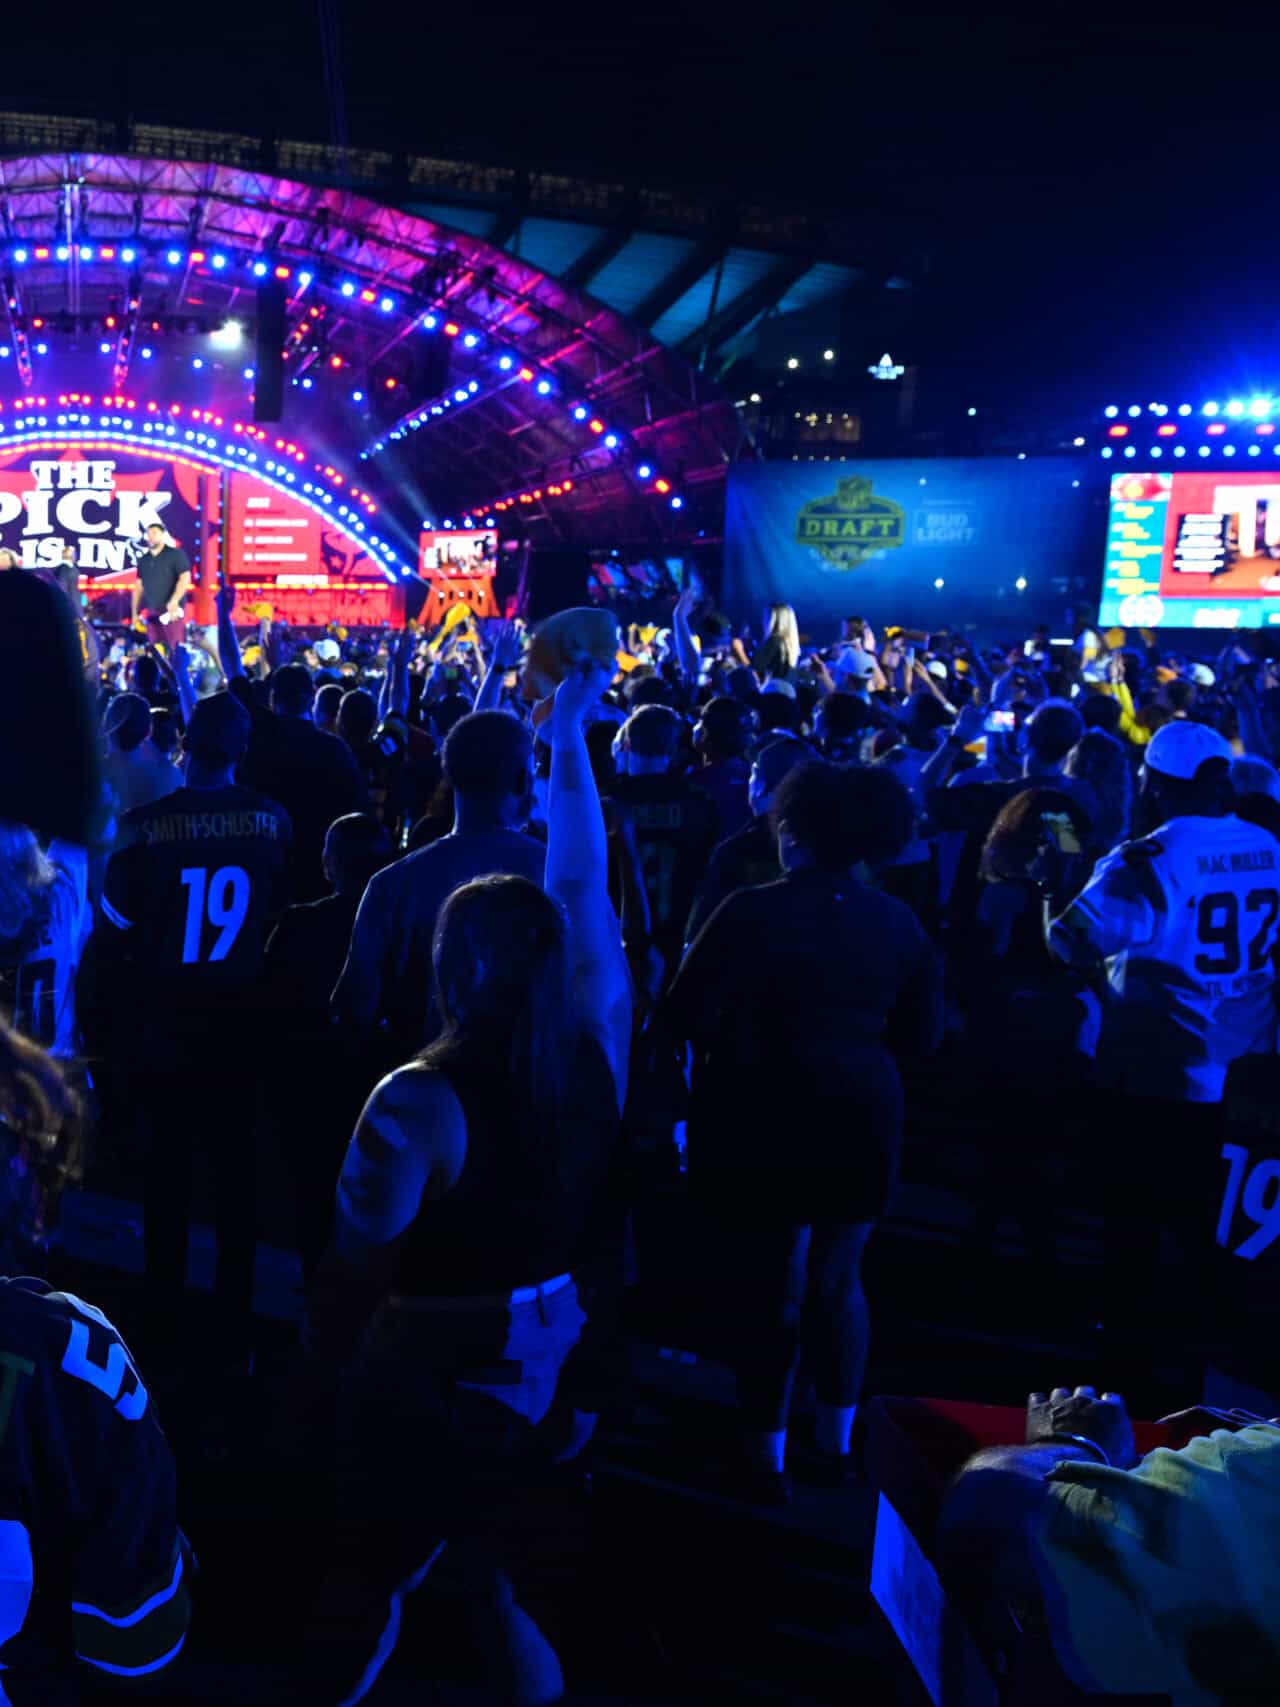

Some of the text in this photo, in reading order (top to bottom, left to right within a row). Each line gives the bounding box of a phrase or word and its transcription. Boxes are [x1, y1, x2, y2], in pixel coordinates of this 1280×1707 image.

[30, 461, 116, 489] THE
[804, 519, 895, 537] DRAFT
[19, 538, 66, 568] IS
[142, 810, 280, 842] SMITH-SCHUSTER
[180, 865, 251, 965] 19
[1215, 1141, 1280, 1261] 19
